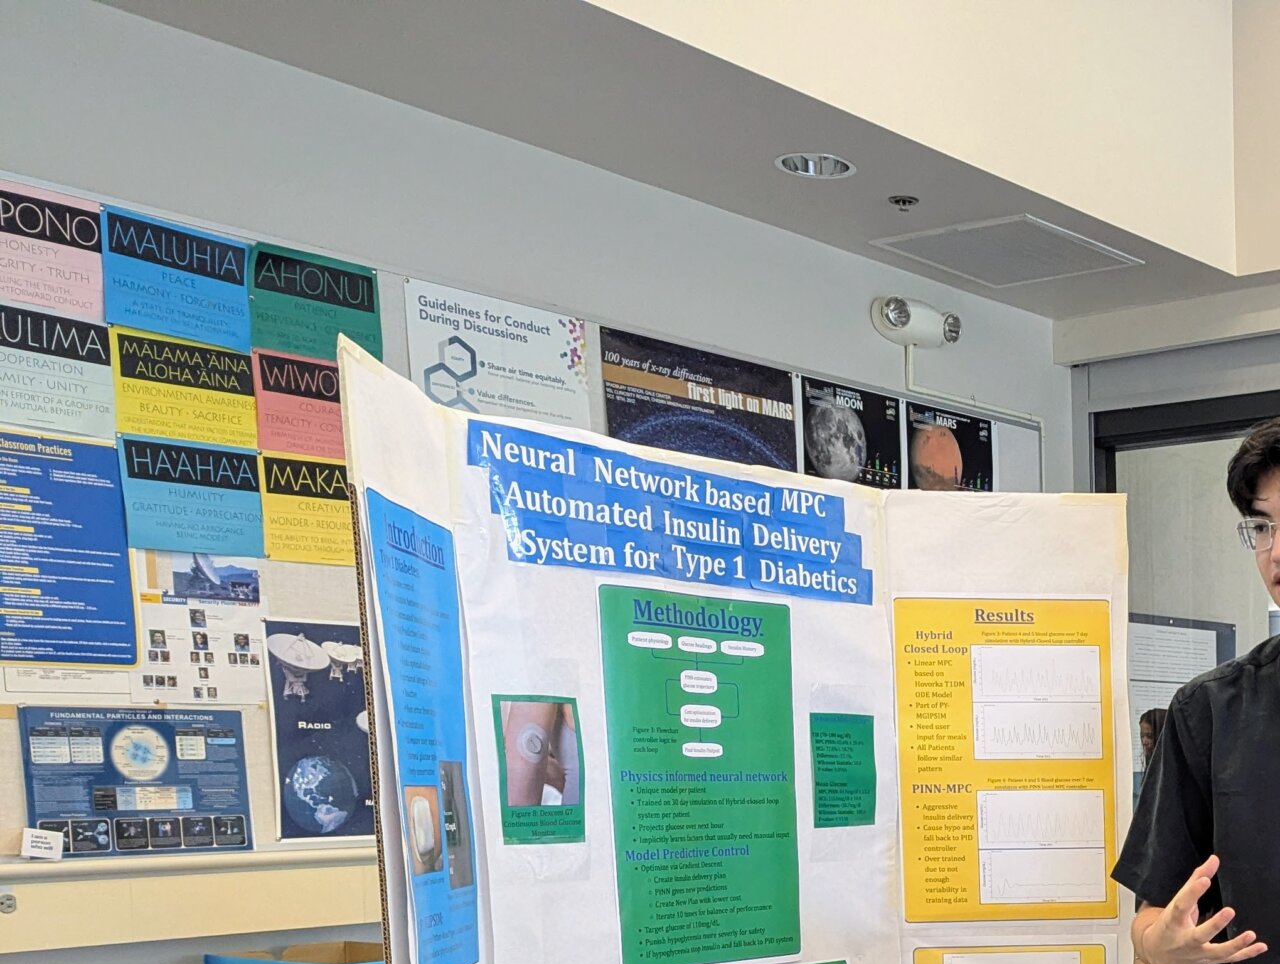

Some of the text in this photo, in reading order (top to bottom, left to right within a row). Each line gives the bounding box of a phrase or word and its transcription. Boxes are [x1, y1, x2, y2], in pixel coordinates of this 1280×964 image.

[0, 198, 98, 246] PONO
[112, 221, 240, 280] MALUHIA
[47, 266, 90, 284] TRUTH
[162, 272, 197, 289] PEACE
[258, 259, 368, 306] AHONUI
[113, 278, 171, 299] HARMONY
[418, 295, 551, 336] Guidelines for Conduct
[419, 309, 529, 343] During Discussions
[0, 312, 106, 360] ULIMA
[135, 361, 194, 383] ALOHA
[487, 361, 507, 375] Share
[508, 366, 517, 375] air
[519, 369, 533, 379] time
[535, 371, 566, 386] equitably.
[604, 350, 713, 385] 100 years of x-ray diffraction:
[0, 372, 88, 395] MILY UNITY
[122, 383, 257, 411] ENVIRONMENTAL AWARENESS
[477, 389, 536, 408] Value differences.
[687, 382, 715, 404] first
[718, 387, 744, 411] light
[746, 397, 760, 414] on
[762, 397, 793, 420] MARS
[836, 395, 863, 411] MOON
[140, 402, 242, 426] BEAUTY SACRIFICE
[265, 413, 312, 429] TENACITY
[936, 415, 957, 430] MARS
[37, 443, 72, 457] Practices
[270, 463, 350, 496] MAKA
[480, 430, 826, 518] Neural Network based MPC
[168, 488, 225, 503] HUMILITY
[132, 502, 188, 516] GRATITUDE
[270, 516, 310, 528] WONDER
[503, 480, 842, 564] Automated Insulin Delivery
[384, 513, 446, 566] Introduction
[520, 529, 858, 595] System for Type 1 Diabetics
[633, 598, 763, 638] Methodology
[974, 608, 1035, 623] Results
[915, 630, 953, 641] Hybrid
[904, 644, 968, 656] Closed Loop
[914, 659, 953, 667] Linear MPC
[914, 669, 934, 677] based
[915, 680, 965, 688] Hovorka T1DM
[50, 711, 105, 719] FUNDAMENTAL
[916, 712, 947, 720] MGIPSIM
[916, 733, 967, 742] input for meals
[917, 754, 963, 762] follow similar
[620, 770, 788, 785] Physics informed neural network
[917, 766, 943, 774] pattern
[636, 786, 660, 795] Unique
[661, 786, 678, 794] model
[912, 783, 972, 794] PINN-MPC
[922, 803, 958, 812] Aggressive
[947, 813, 974, 822] delivery
[944, 824, 961, 832] hypo
[625, 845, 750, 862] Model Predictive Control
[925, 876, 950, 884] enough
[925, 886, 959, 895] variability
[925, 896, 968, 905] training data
